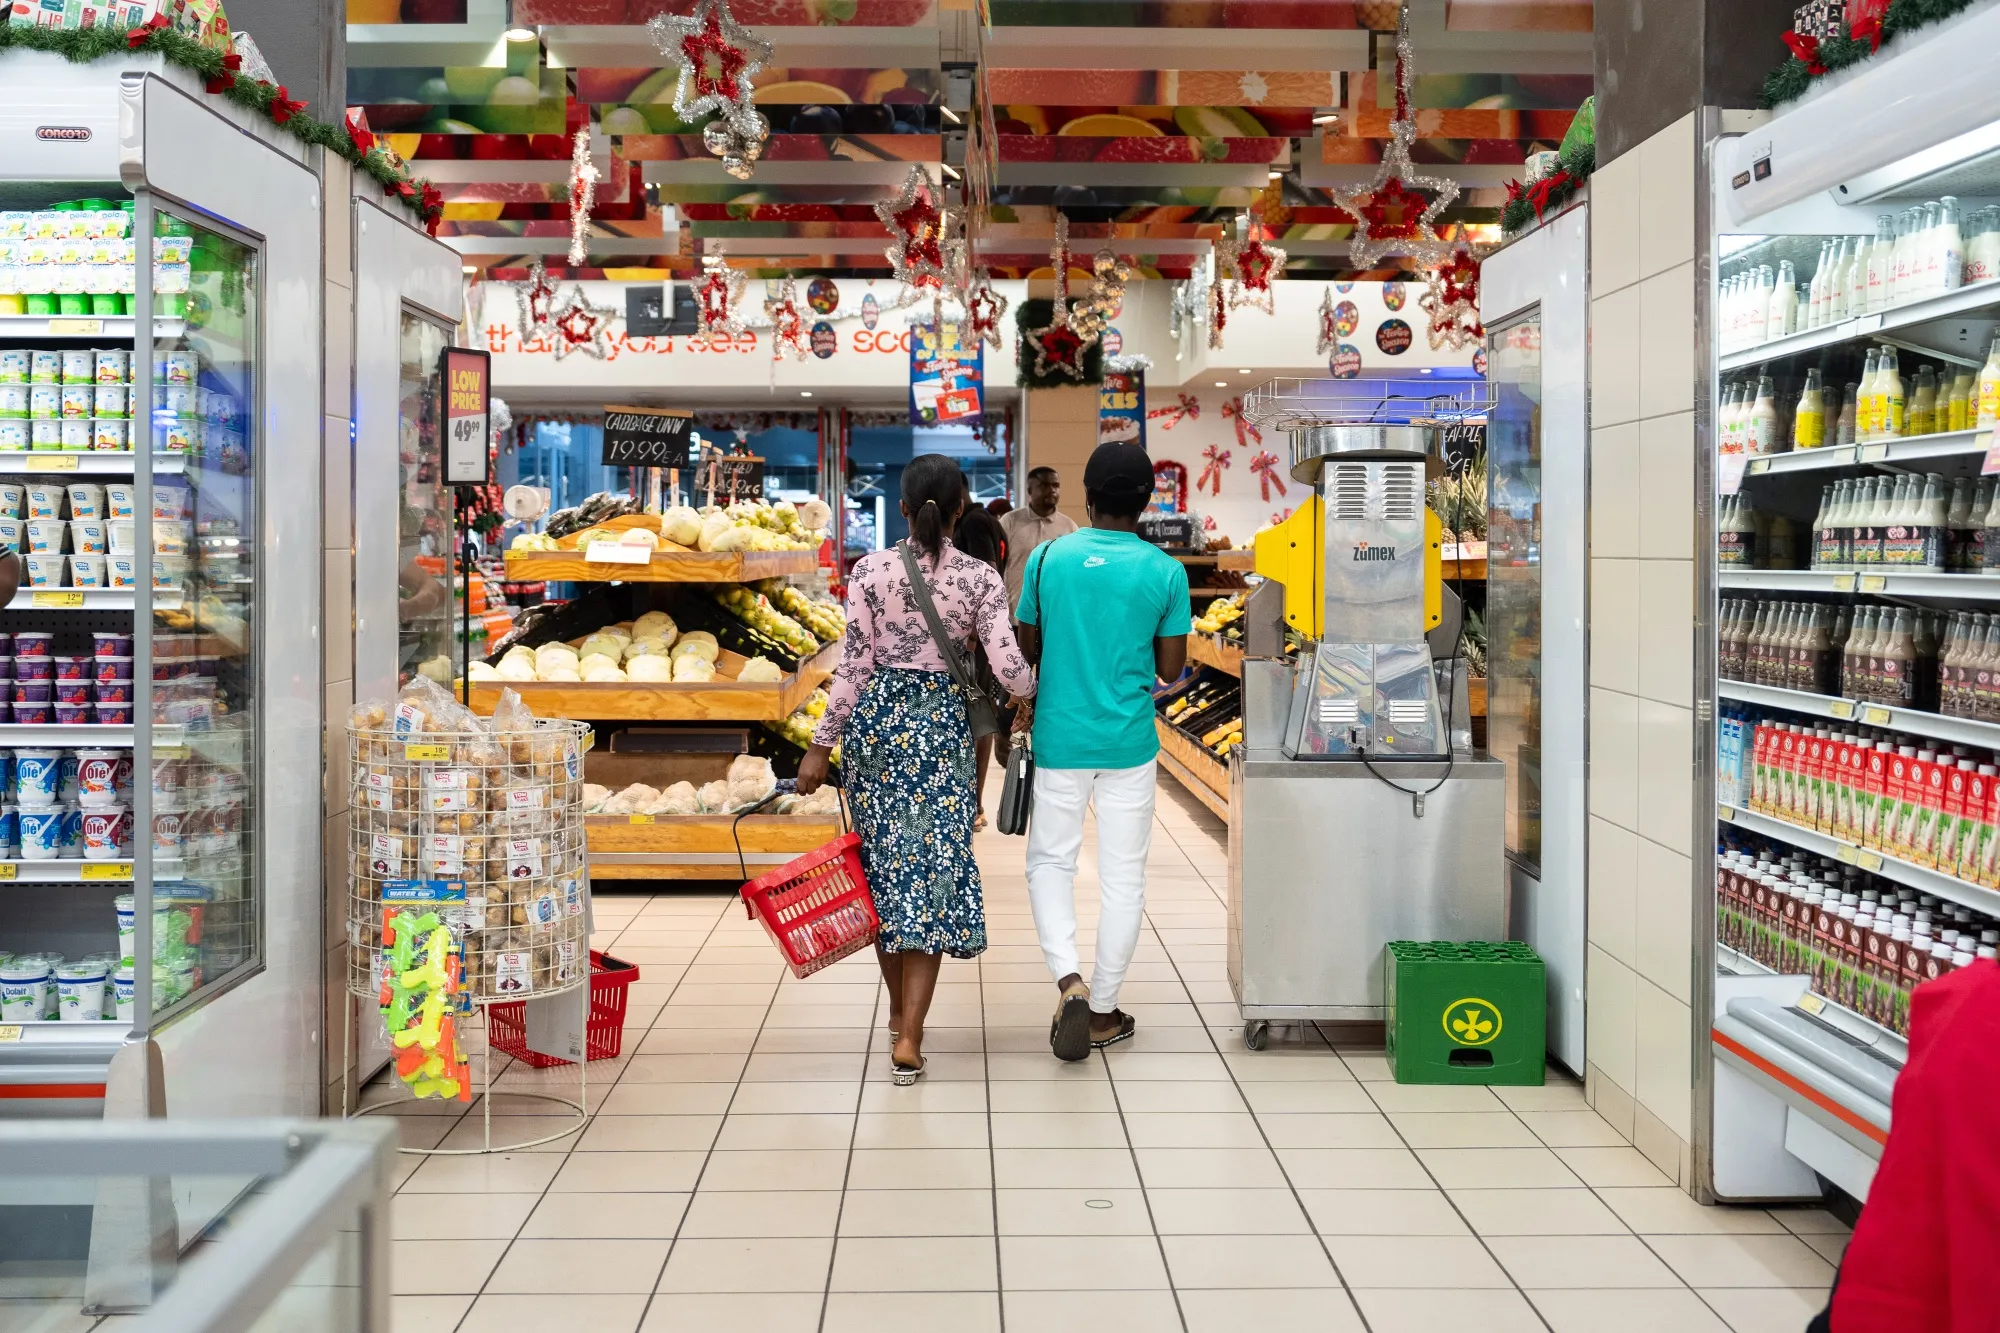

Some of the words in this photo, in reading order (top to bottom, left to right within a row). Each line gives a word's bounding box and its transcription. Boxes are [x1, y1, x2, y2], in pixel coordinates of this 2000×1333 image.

[451, 370, 480, 391] LOW
[451, 392, 480, 410] PRICE
[1101, 392, 1138, 409] KES
[605, 413, 654, 433] CABBAGE
[656, 417, 685, 434] UNW
[5, 987, 27, 995] Dolait
[119, 987, 134, 995] Dola
